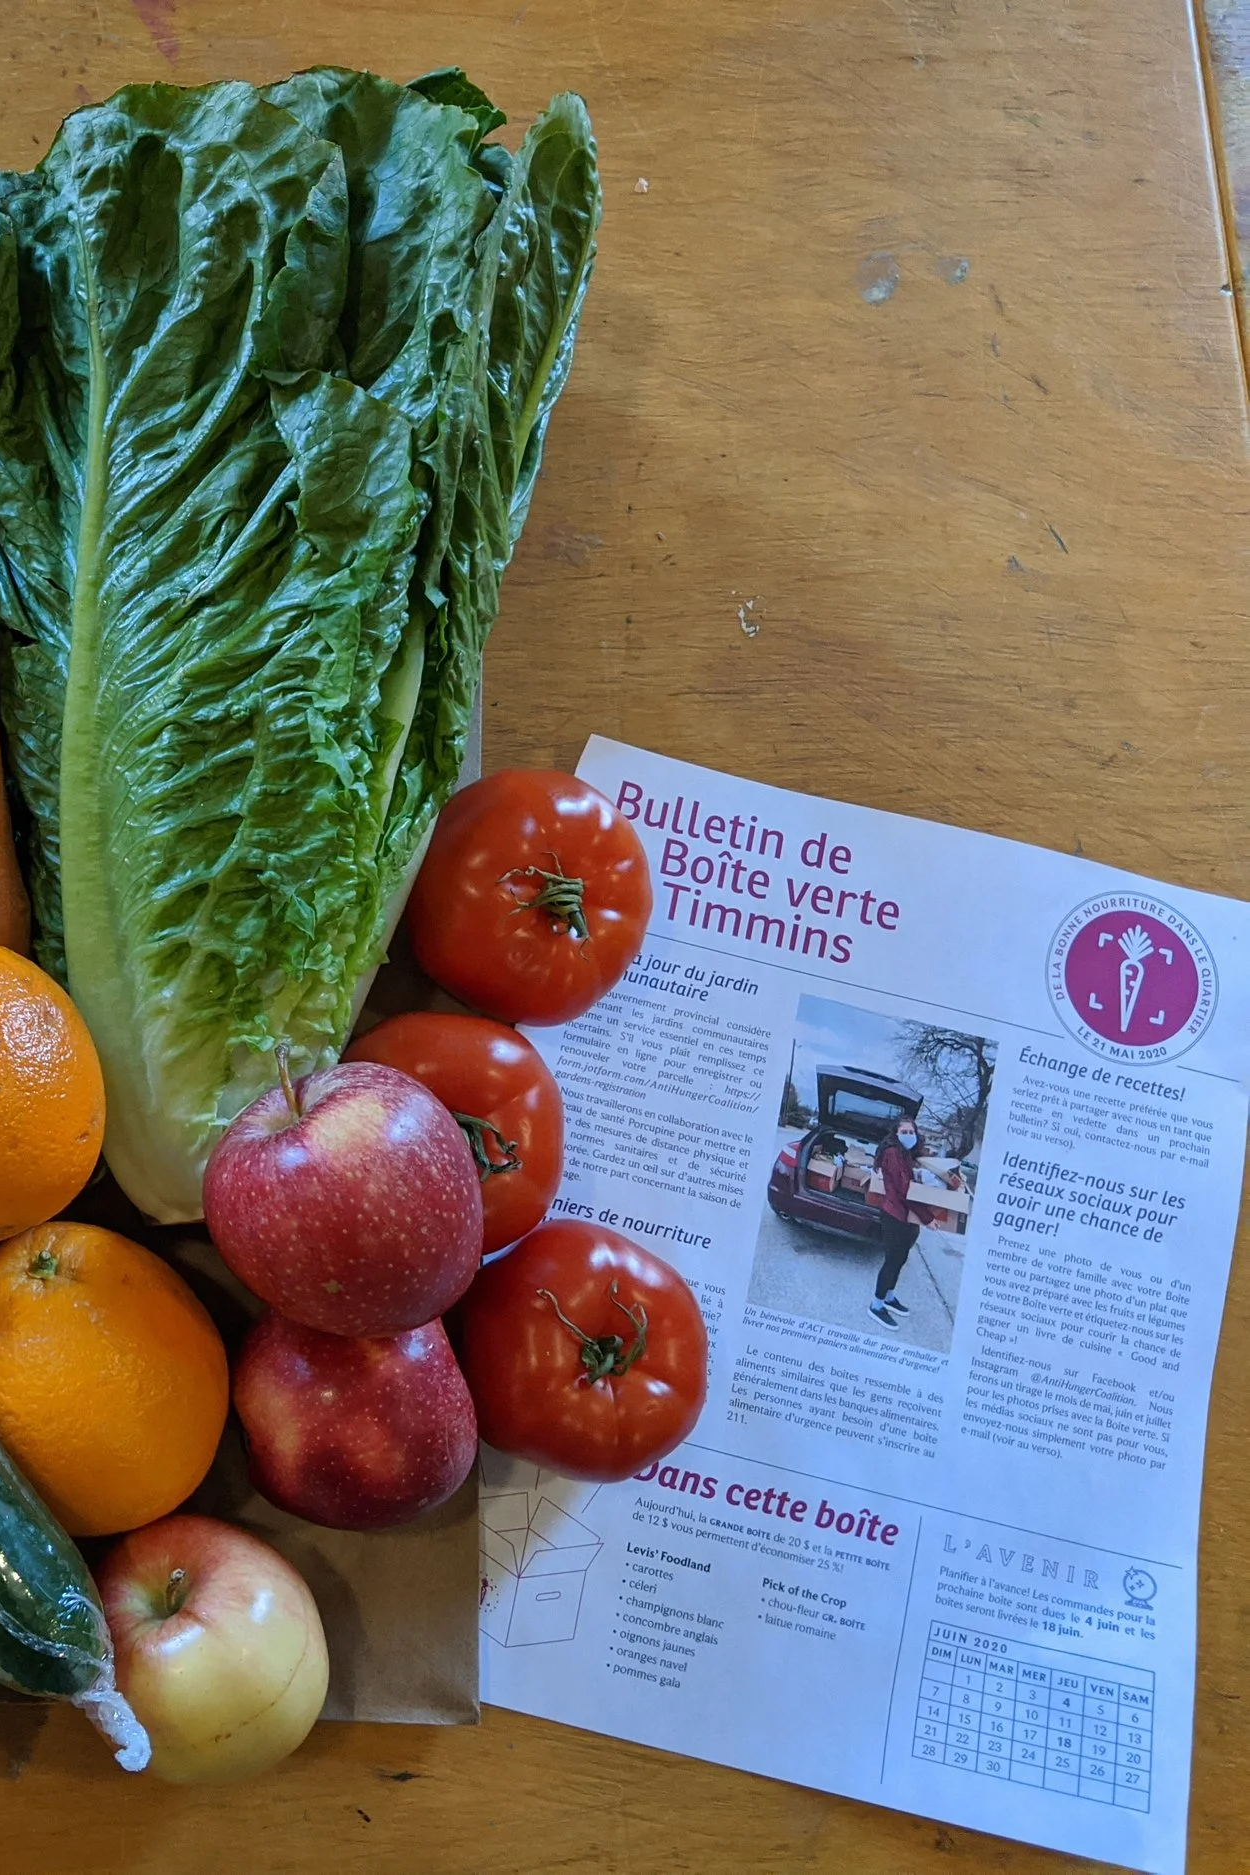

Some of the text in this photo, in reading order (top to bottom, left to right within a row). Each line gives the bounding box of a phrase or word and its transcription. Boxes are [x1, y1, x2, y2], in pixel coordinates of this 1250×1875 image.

[615, 780, 852, 874] Bulletin de
[659, 837, 900, 931] Boîte verte
[662, 881, 853, 964] Timmins
[641, 953, 759, 995] jour du jardin
[1052, 897, 1212, 1035] DE LA BONNE NOURRITURE DANS LE QUARTIER
[623, 970, 709, 1002] unautaire
[1077, 1025, 1167, 1060] LE 21 MAI 2020
[1018, 1044, 1186, 1102] Échange de recettes!
[1002, 1150, 1186, 1209] Identifiez-nous sur les
[998, 1172, 1178, 1226] réseaux sociaux pour
[551, 1197, 712, 1249] niers de nourriture
[991, 1210, 1060, 1237] gagner!
[996, 1191, 1163, 1243] avoir une chance de
[725, 1483, 808, 1523] cette
[813, 1498, 899, 1546] boîte
[631, 1562, 674, 1581] carottes
[659, 1550, 711, 1573] Foodland
[628, 1578, 657, 1594] céleri
[761, 1576, 847, 1610] Pick of the Crop
[621, 1612, 718, 1645] concombre anglais
[625, 1595, 725, 1630] champignons blanc
[764, 1611, 837, 1641] laitue romaine
[618, 1628, 695, 1657] oignons jaunes
[933, 1627, 1008, 1654] JUIN 2020
[611, 1663, 681, 1689] pommes gala
[615, 1646, 688, 1672] oranges navel
[931, 1646, 1149, 1705] DIM LUN MAR MER JEU VEN SAM
